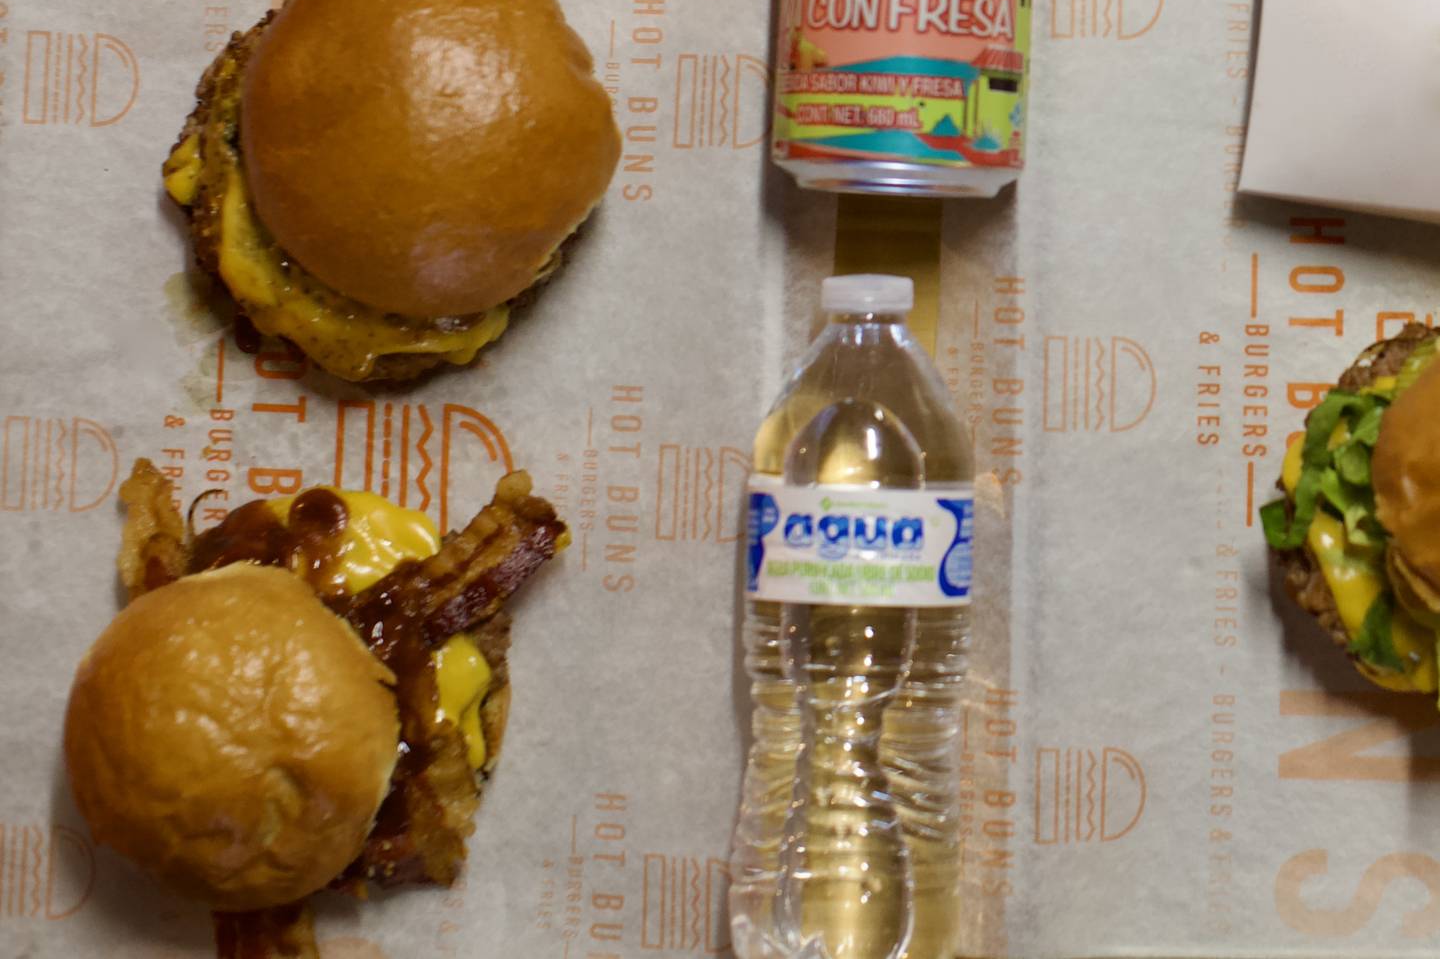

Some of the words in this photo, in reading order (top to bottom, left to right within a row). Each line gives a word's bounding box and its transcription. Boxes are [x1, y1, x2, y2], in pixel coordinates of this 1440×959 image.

[1225, 2, 1250, 80] FRIES
[911, 76, 965, 98] FRESA
[623, 97, 659, 203] BUNS
[992, 276, 1025, 352] HOT
[1288, 216, 1346, 337] HOT
[1199, 331, 1221, 345] &
[163, 414, 187, 429] &
[251, 350, 308, 423] OT
[607, 384, 645, 459] HOT
[1196, 365, 1222, 447] FRIES
[1242, 323, 1271, 457] BURGERS
[202, 408, 236, 523] BURGER
[990, 377, 1025, 488] BUNS
[602, 485, 642, 594] BUNS
[1213, 569, 1239, 649] FRIES
[984, 688, 1017, 764] HOT
[1210, 694, 1237, 817] BURGERS
[592, 792, 627, 868] HOT
[981, 788, 1016, 898] BUNS
